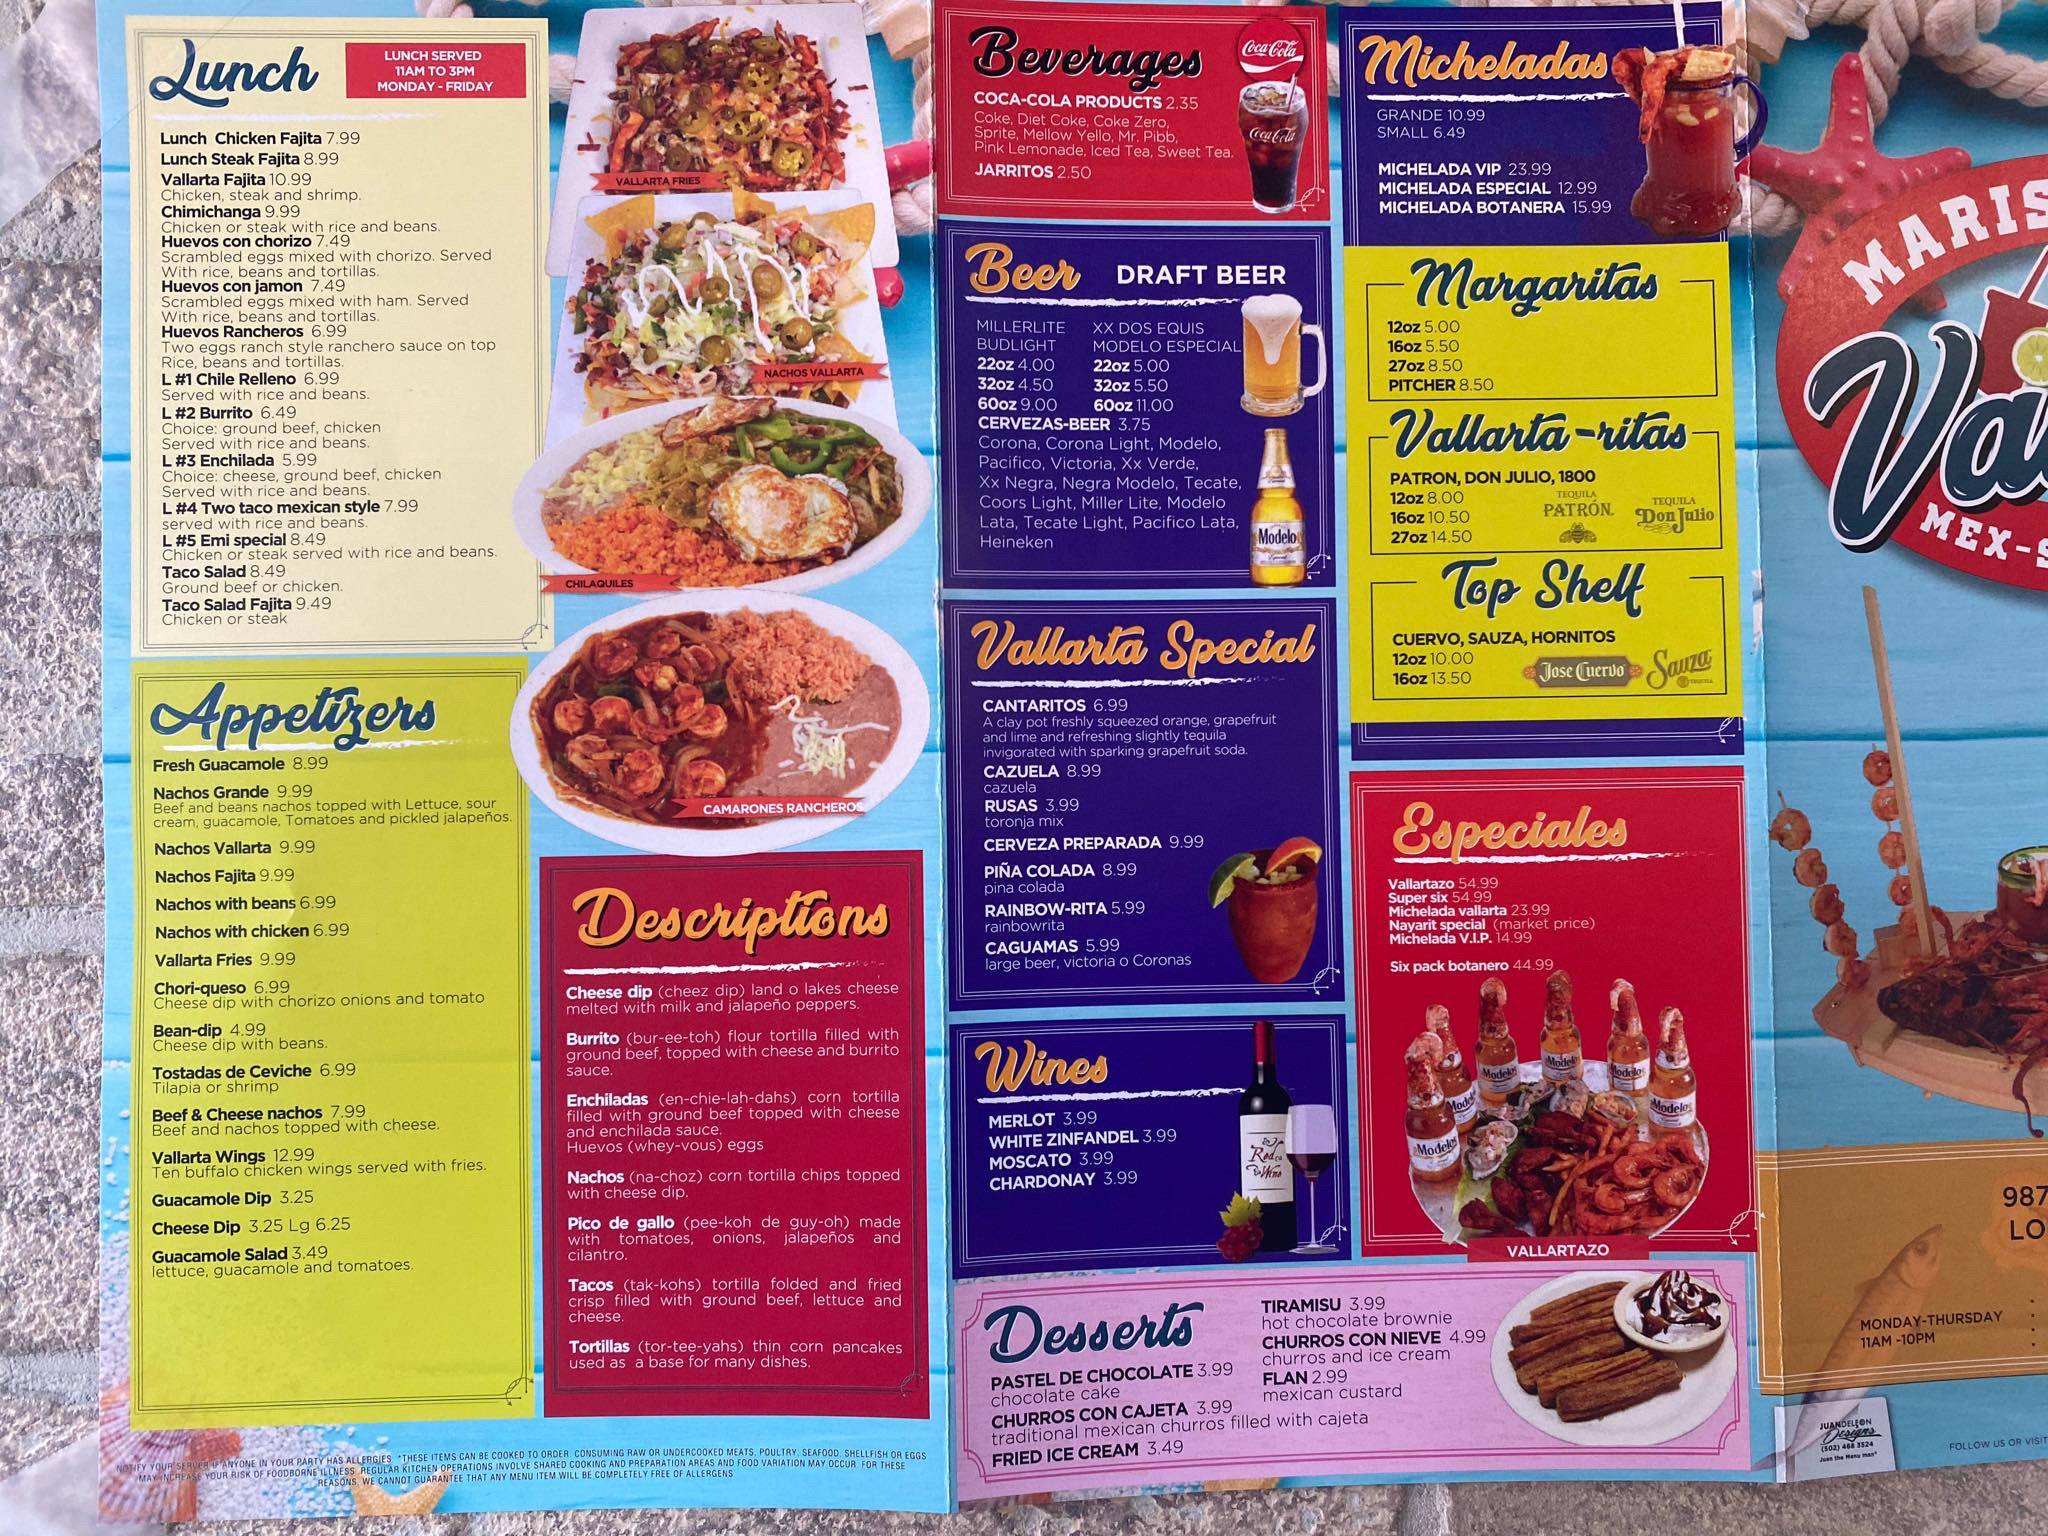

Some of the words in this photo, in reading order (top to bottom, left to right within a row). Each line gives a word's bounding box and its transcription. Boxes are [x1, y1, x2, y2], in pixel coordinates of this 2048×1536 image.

[385, 51, 428, 60] LUNCH
[432, 51, 482, 60] SERVED
[968, 26, 1202, 93] Beverages
[1359, 34, 1607, 88] Micheladas
[149, 38, 319, 108] Lunch
[396, 66, 424, 76] 11AM
[428, 66, 446, 76] TO
[449, 66, 474, 76] 3PM
[378, 82, 435, 92] MONDAY
[446, 82, 494, 92] FRIDAY
[974, 90, 1072, 108] COCA-COLA
[1076, 95, 1162, 109] PRODUCTS
[1166, 97, 1198, 109] 2.35
[161, 132, 206, 144] Lunch
[215, 132, 276, 144] Chicken
[281, 132, 322, 147] Fajita
[326, 132, 360, 144] 7.99
[975, 141, 1004, 153] Pink
[1009, 142, 1086, 156] Lemonade,
[1092, 145, 1120, 156] Iced
[1126, 145, 1152, 158] Tea,
[1158, 146, 1200, 158] Sweet
[1206, 146, 1233, 158] Tea.
[615, 175, 670, 186] VALLARTA
[672, 175, 701, 186] FRIES
[162, 190, 224, 202] Chicken,
[230, 190, 269, 200] steak
[275, 189, 301, 200] and
[308, 189, 360, 202] shrimp.
[1380, 201, 1473, 213] MICHELADA
[1477, 201, 1565, 214] BOTANERA
[1573, 201, 1611, 213] 15.99
[964, 242, 1081, 294] Beer
[1118, 265, 1207, 284] DRAFT
[1217, 266, 1286, 284] BEER
[1410, 257, 1658, 318] Margaritas
[977, 319, 1066, 334] MILLERLITE
[1094, 321, 1114, 335] XX
[1119, 321, 1153, 335] DOS
[1157, 321, 1205, 335] EQUIS
[764, 368, 808, 378] NACHOS
[810, 366, 865, 377] VALLARTA
[1389, 408, 1570, 458] Vallarta
[1391, 472, 1461, 486] PATRON,
[1465, 471, 1501, 484] DON
[1505, 471, 1554, 485] JULIO,
[1558, 470, 1595, 482] 1800
[1556, 490, 1597, 499] TEQUILA
[1652, 497, 1696, 506] TEQUILA
[163, 502, 172, 514] L
[176, 502, 197, 514] #4
[201, 502, 235, 514] Two
[239, 502, 273, 514] taco
[277, 500, 340, 513] mexican
[345, 500, 380, 515] style
[384, 500, 418, 512] 7.99
[1258, 528, 1297, 545] Modelo
[565, 580, 634, 588] CHILAQUILES
[1441, 556, 1521, 619] Top
[1534, 558, 1646, 619] Shelf
[971, 619, 1148, 670] Vallarta
[1160, 619, 1316, 678] Special
[1539, 662, 1573, 682] Jose
[1575, 661, 1625, 682] Cuervo
[1646, 649, 1712, 689] Sauza
[983, 699, 1086, 712] CANTARITOS
[1094, 699, 1127, 712] 6.99
[150, 681, 436, 752] Appetizers
[154, 758, 194, 772] Fresh
[199, 757, 285, 771] Guacamole
[293, 757, 328, 770] 8.99
[703, 803, 784, 815] CAMARONES
[786, 801, 863, 814] RANCHEROS
[154, 819, 198, 827] cream,
[204, 816, 280, 829] guacamole,
[286, 815, 354, 825] Tomatoes
[360, 814, 384, 824] and
[390, 812, 438, 825] pickled
[444, 812, 512, 825] jalapeños.
[1392, 801, 1628, 865] Especiales
[1389, 905, 1455, 918] Michelada
[1458, 905, 1507, 917] vallarta
[1511, 904, 1550, 916] 23.99
[572, 886, 889, 956] Descriptions
[154, 1024, 222, 1039] Bean-dip
[230, 1023, 265, 1036] 4.99
[567, 1032, 620, 1045] Burrito
[627, 1030, 720, 1046] (bur-ee-toh)
[728, 1030, 762, 1042] flour
[770, 1029, 816, 1041] tortilla
[826, 1028, 859, 1040] filled
[868, 1028, 898, 1040] with
[974, 1040, 1108, 1092] Wines
[989, 1134, 1042, 1149] WHITE
[1047, 1130, 1139, 1146] ZINFANDEL
[1143, 1129, 1176, 1142] 3.99
[1507, 1244, 1610, 1258] VALLARTAZO
[1861, 1311, 2002, 1331] MONDAY-THURSDAY
[983, 1301, 1204, 1364] Desserts
[1262, 1334, 1344, 1349] CHURROS
[1349, 1332, 1386, 1346] CON
[1391, 1331, 1441, 1345] NIEVE
[1450, 1330, 1485, 1343] 4.99
[1861, 1336, 1891, 1348] 11AM
[1896, 1332, 1935, 1344] -10PM
[1949, 1441, 1990, 1451] FOLLOW
[1993, 1440, 2005, 1448] US
[2008, 1438, 2022, 1447] OR
[378, 1476, 411, 1485] CANNOT
[414, 1475, 463, 1484] GUARANTEE
[466, 1474, 487, 1482] THAT
[490, 1473, 507, 1481] ANY
[509, 1472, 534, 1480] MENU
[536, 1472, 555, 1480] ITEM
[559, 1471, 578, 1480] WILL
[582, 1471, 592, 1479] BE
[595, 1470, 648, 1479] COMPLETELY
[650, 1470, 670, 1478] FREE
[673, 1470, 684, 1478] OF
[686, 1470, 733, 1478] ALLERGENS
